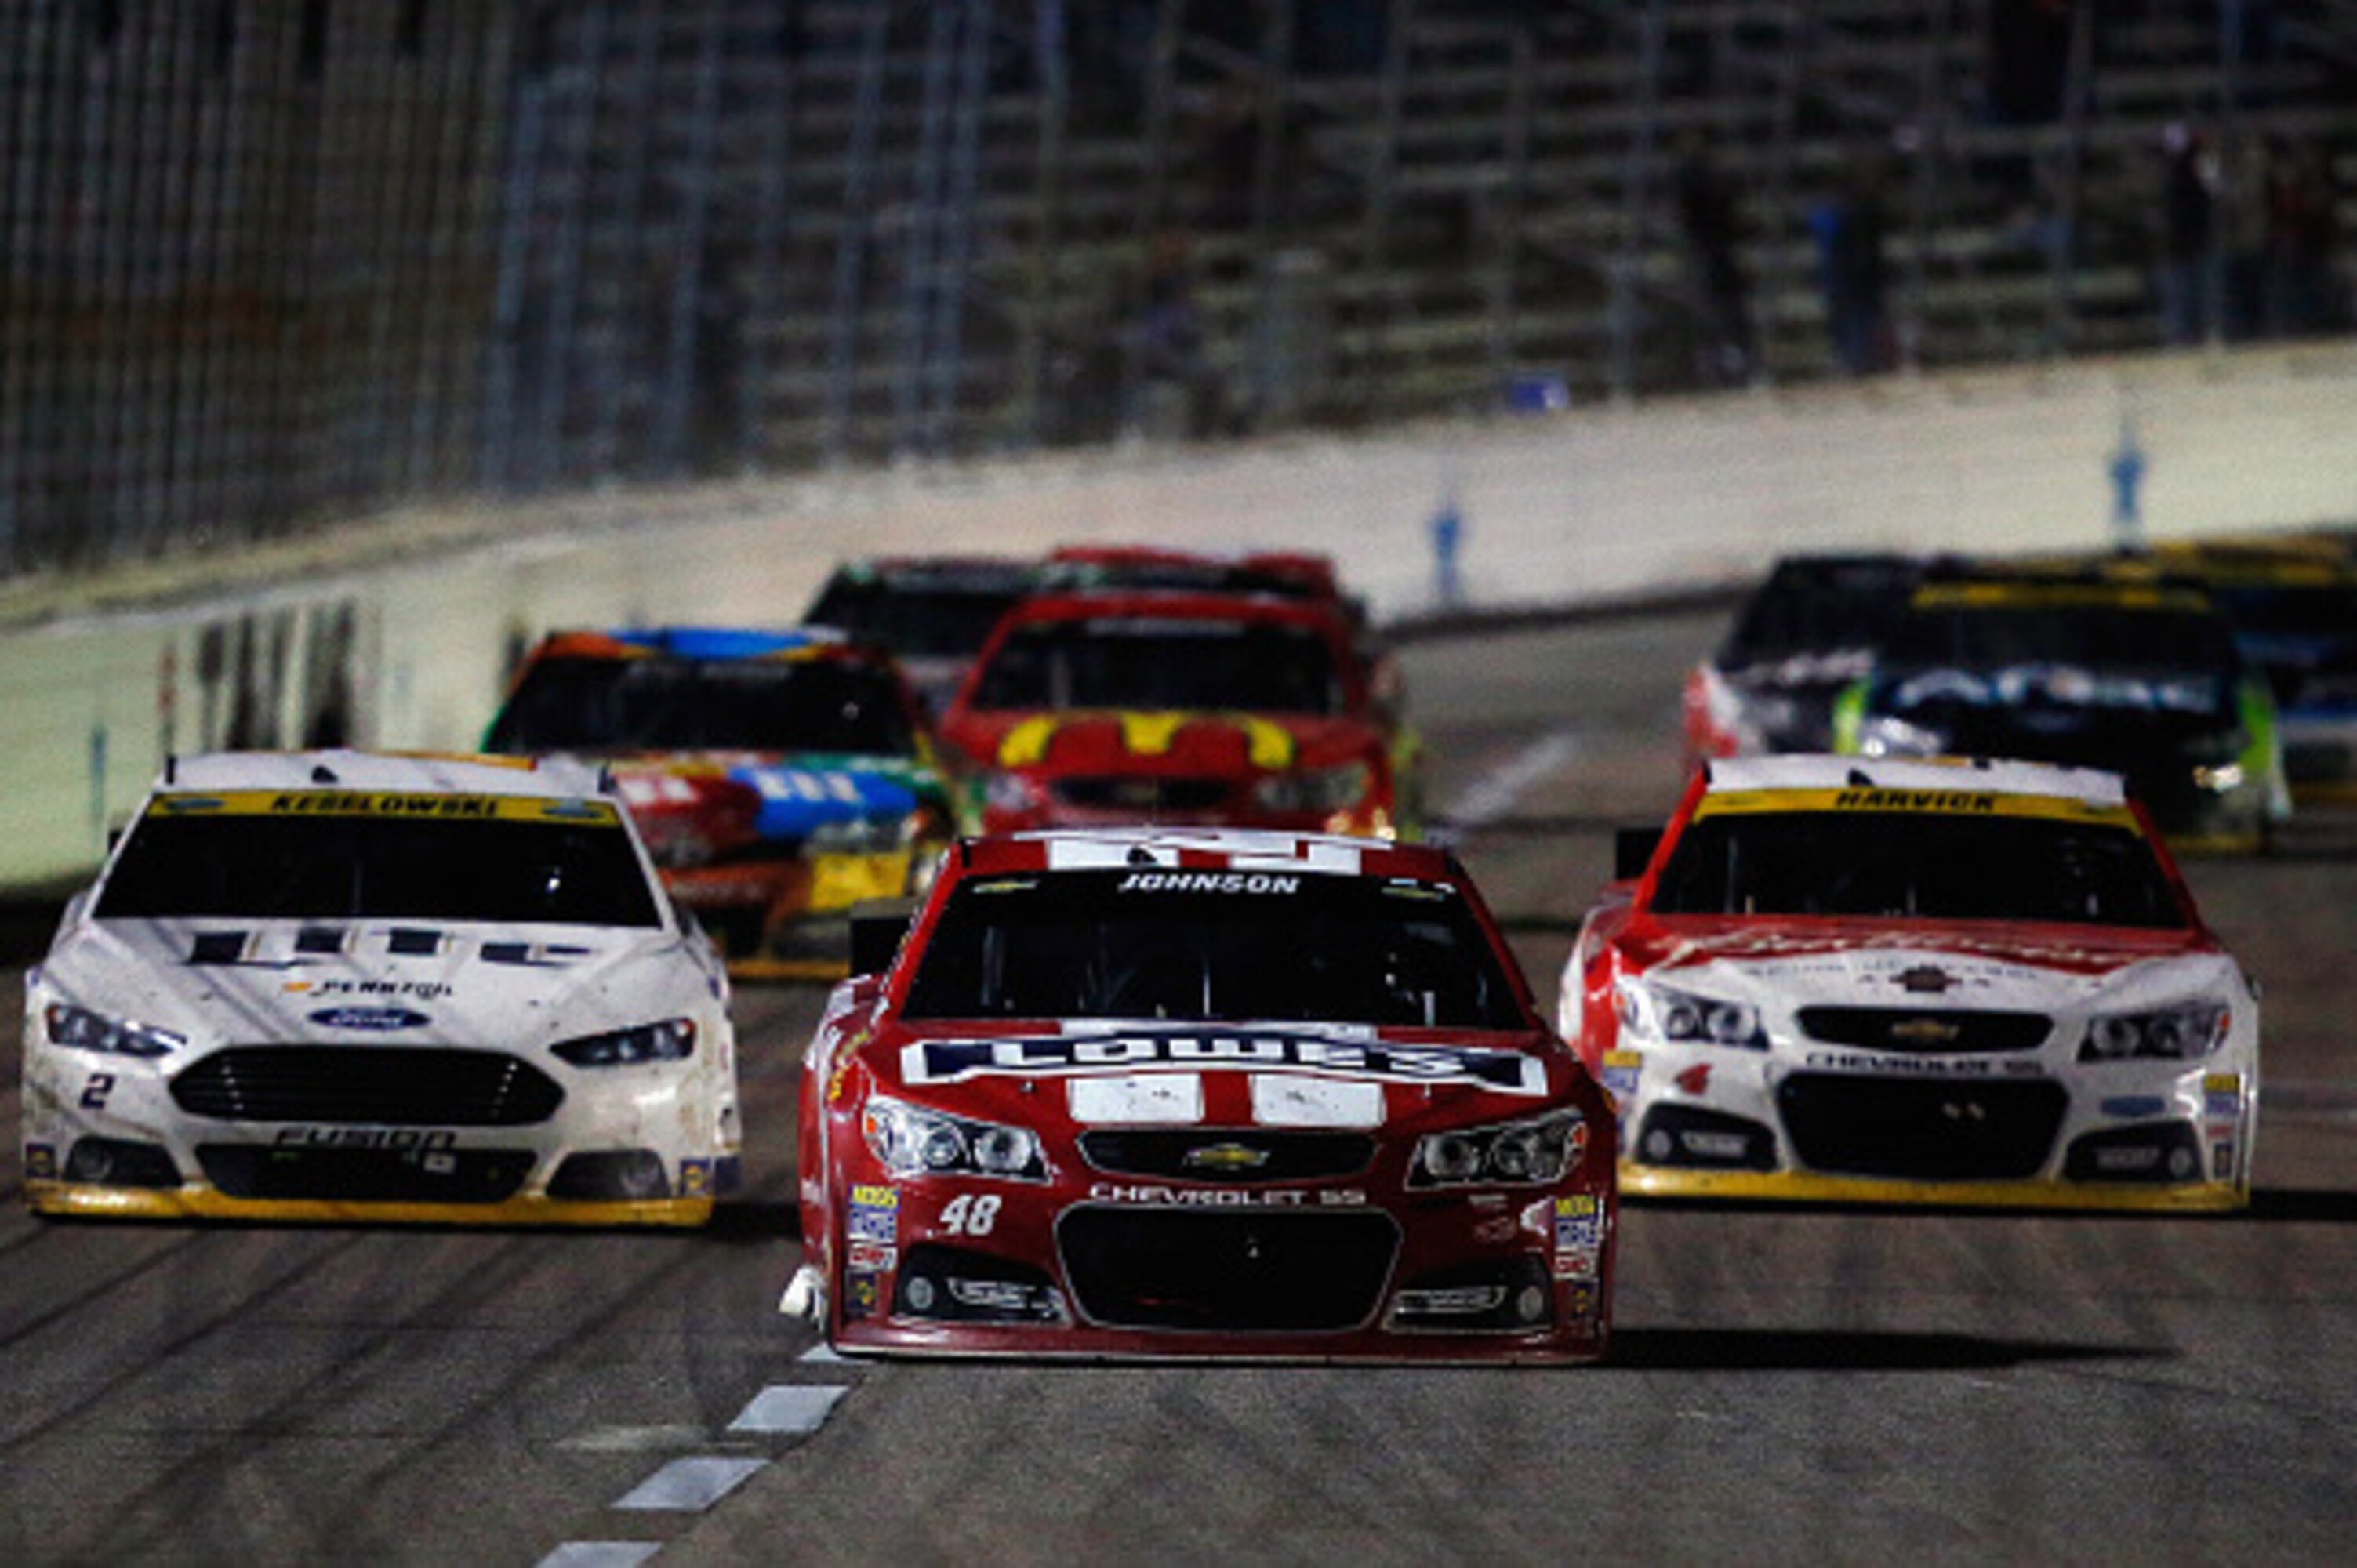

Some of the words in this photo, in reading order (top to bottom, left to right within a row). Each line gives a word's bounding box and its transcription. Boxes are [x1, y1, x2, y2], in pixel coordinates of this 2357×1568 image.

[271, 792, 499, 818] KESELOWSKI
[1836, 787, 1996, 813] HARVICK
[1117, 872, 1300, 896] JOHNSON
[80, 1073, 115, 1109] 2
[1088, 1182, 1306, 1206] CHEVROLET
[1319, 1189, 1366, 1206] SS
[939, 1194, 1001, 1236] 48
